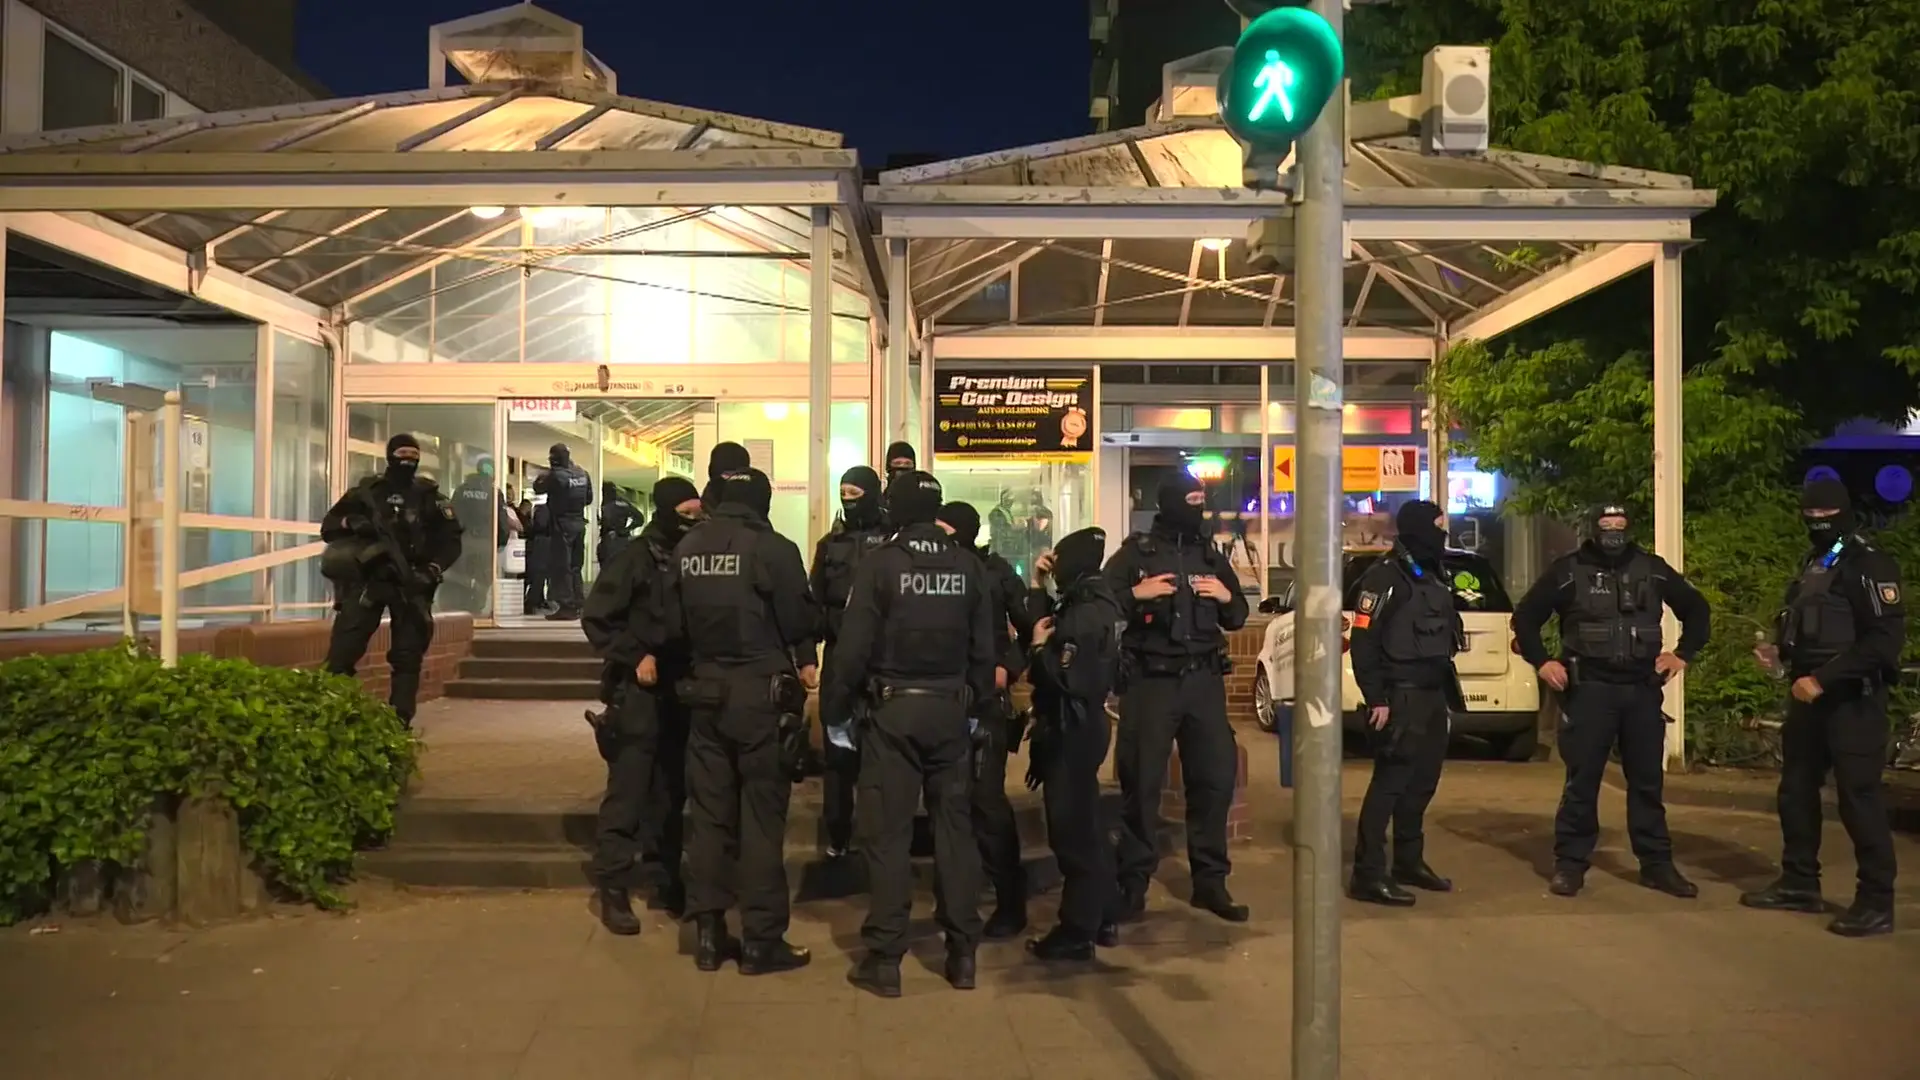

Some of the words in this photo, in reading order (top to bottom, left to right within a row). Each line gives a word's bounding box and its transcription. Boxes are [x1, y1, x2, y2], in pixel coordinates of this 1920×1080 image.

[949, 376, 1045, 390] Premium
[961, 391, 1002, 406] Car
[1005, 390, 1078, 408] Design
[680, 554, 741, 578] POLIZEI
[900, 573, 966, 595] POLIZEI
